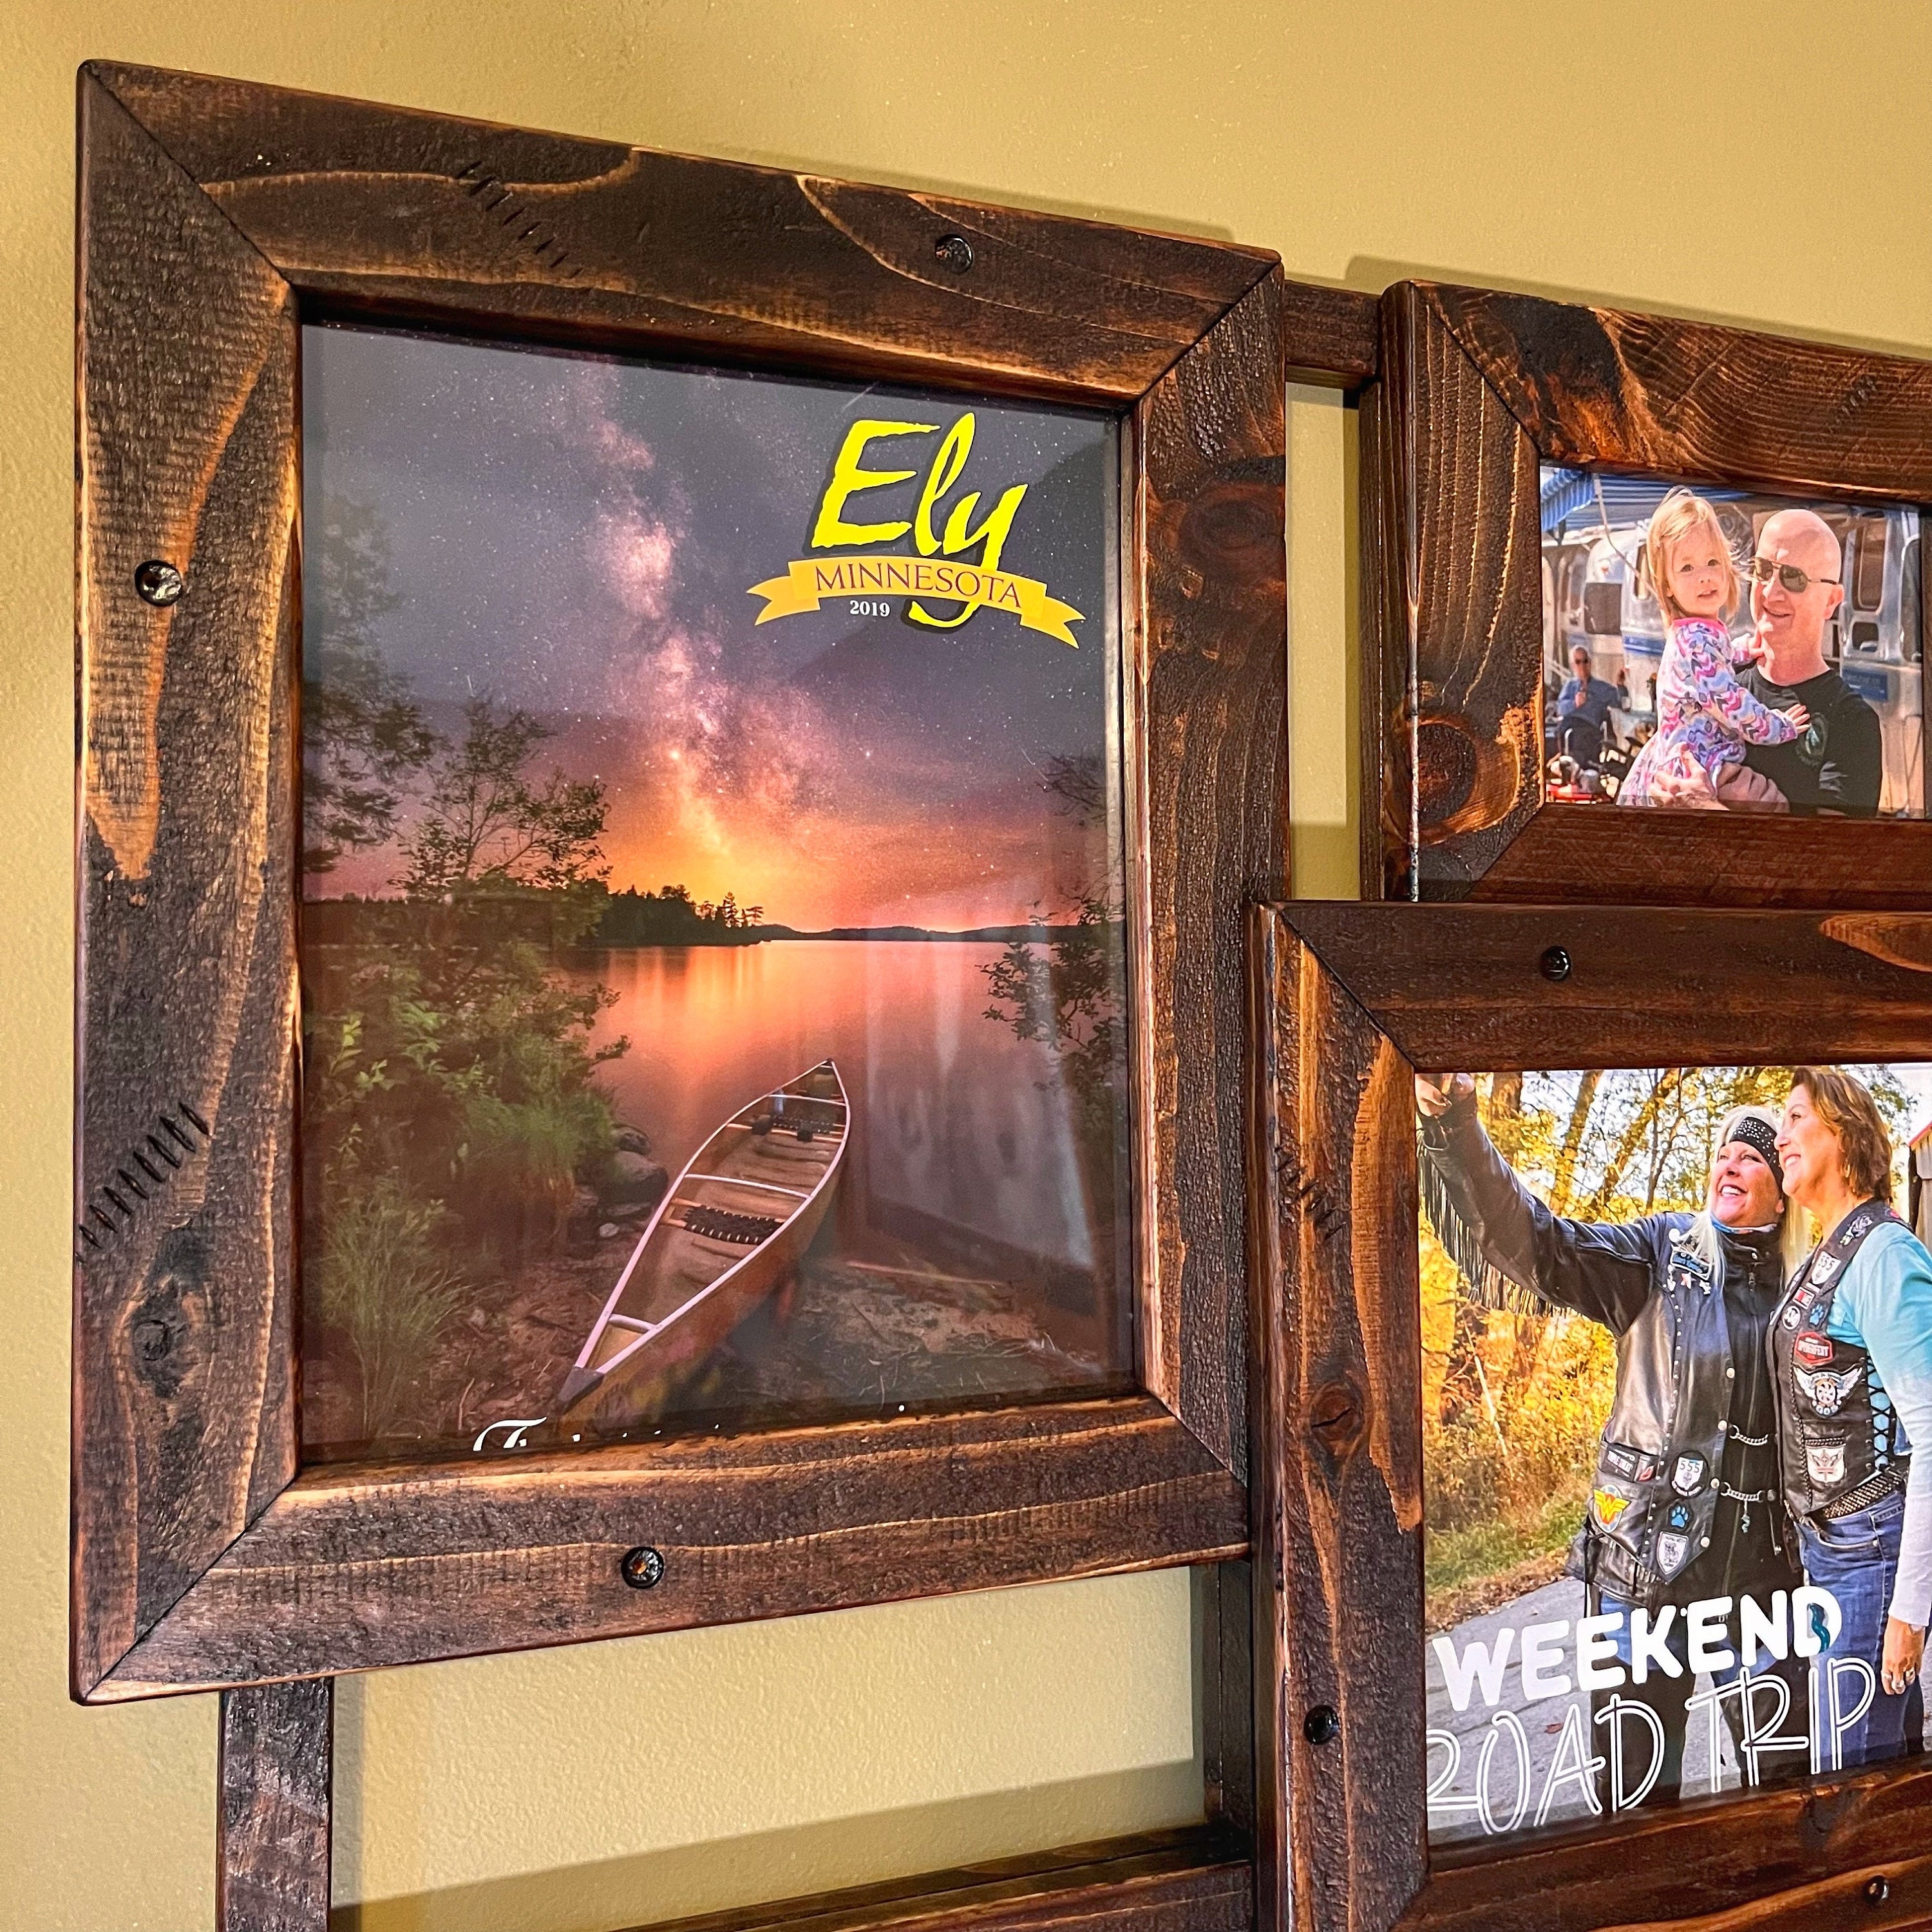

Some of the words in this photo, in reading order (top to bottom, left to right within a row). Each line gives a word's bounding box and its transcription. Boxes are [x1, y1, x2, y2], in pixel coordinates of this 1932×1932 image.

[811, 412, 1028, 628] Ely
[815, 562, 1022, 609] MINNESOTA
[849, 600, 890, 618] 2019
[1431, 1586, 1842, 1712] WEEKEND
[1685, 1656, 1877, 1794] TRIP
